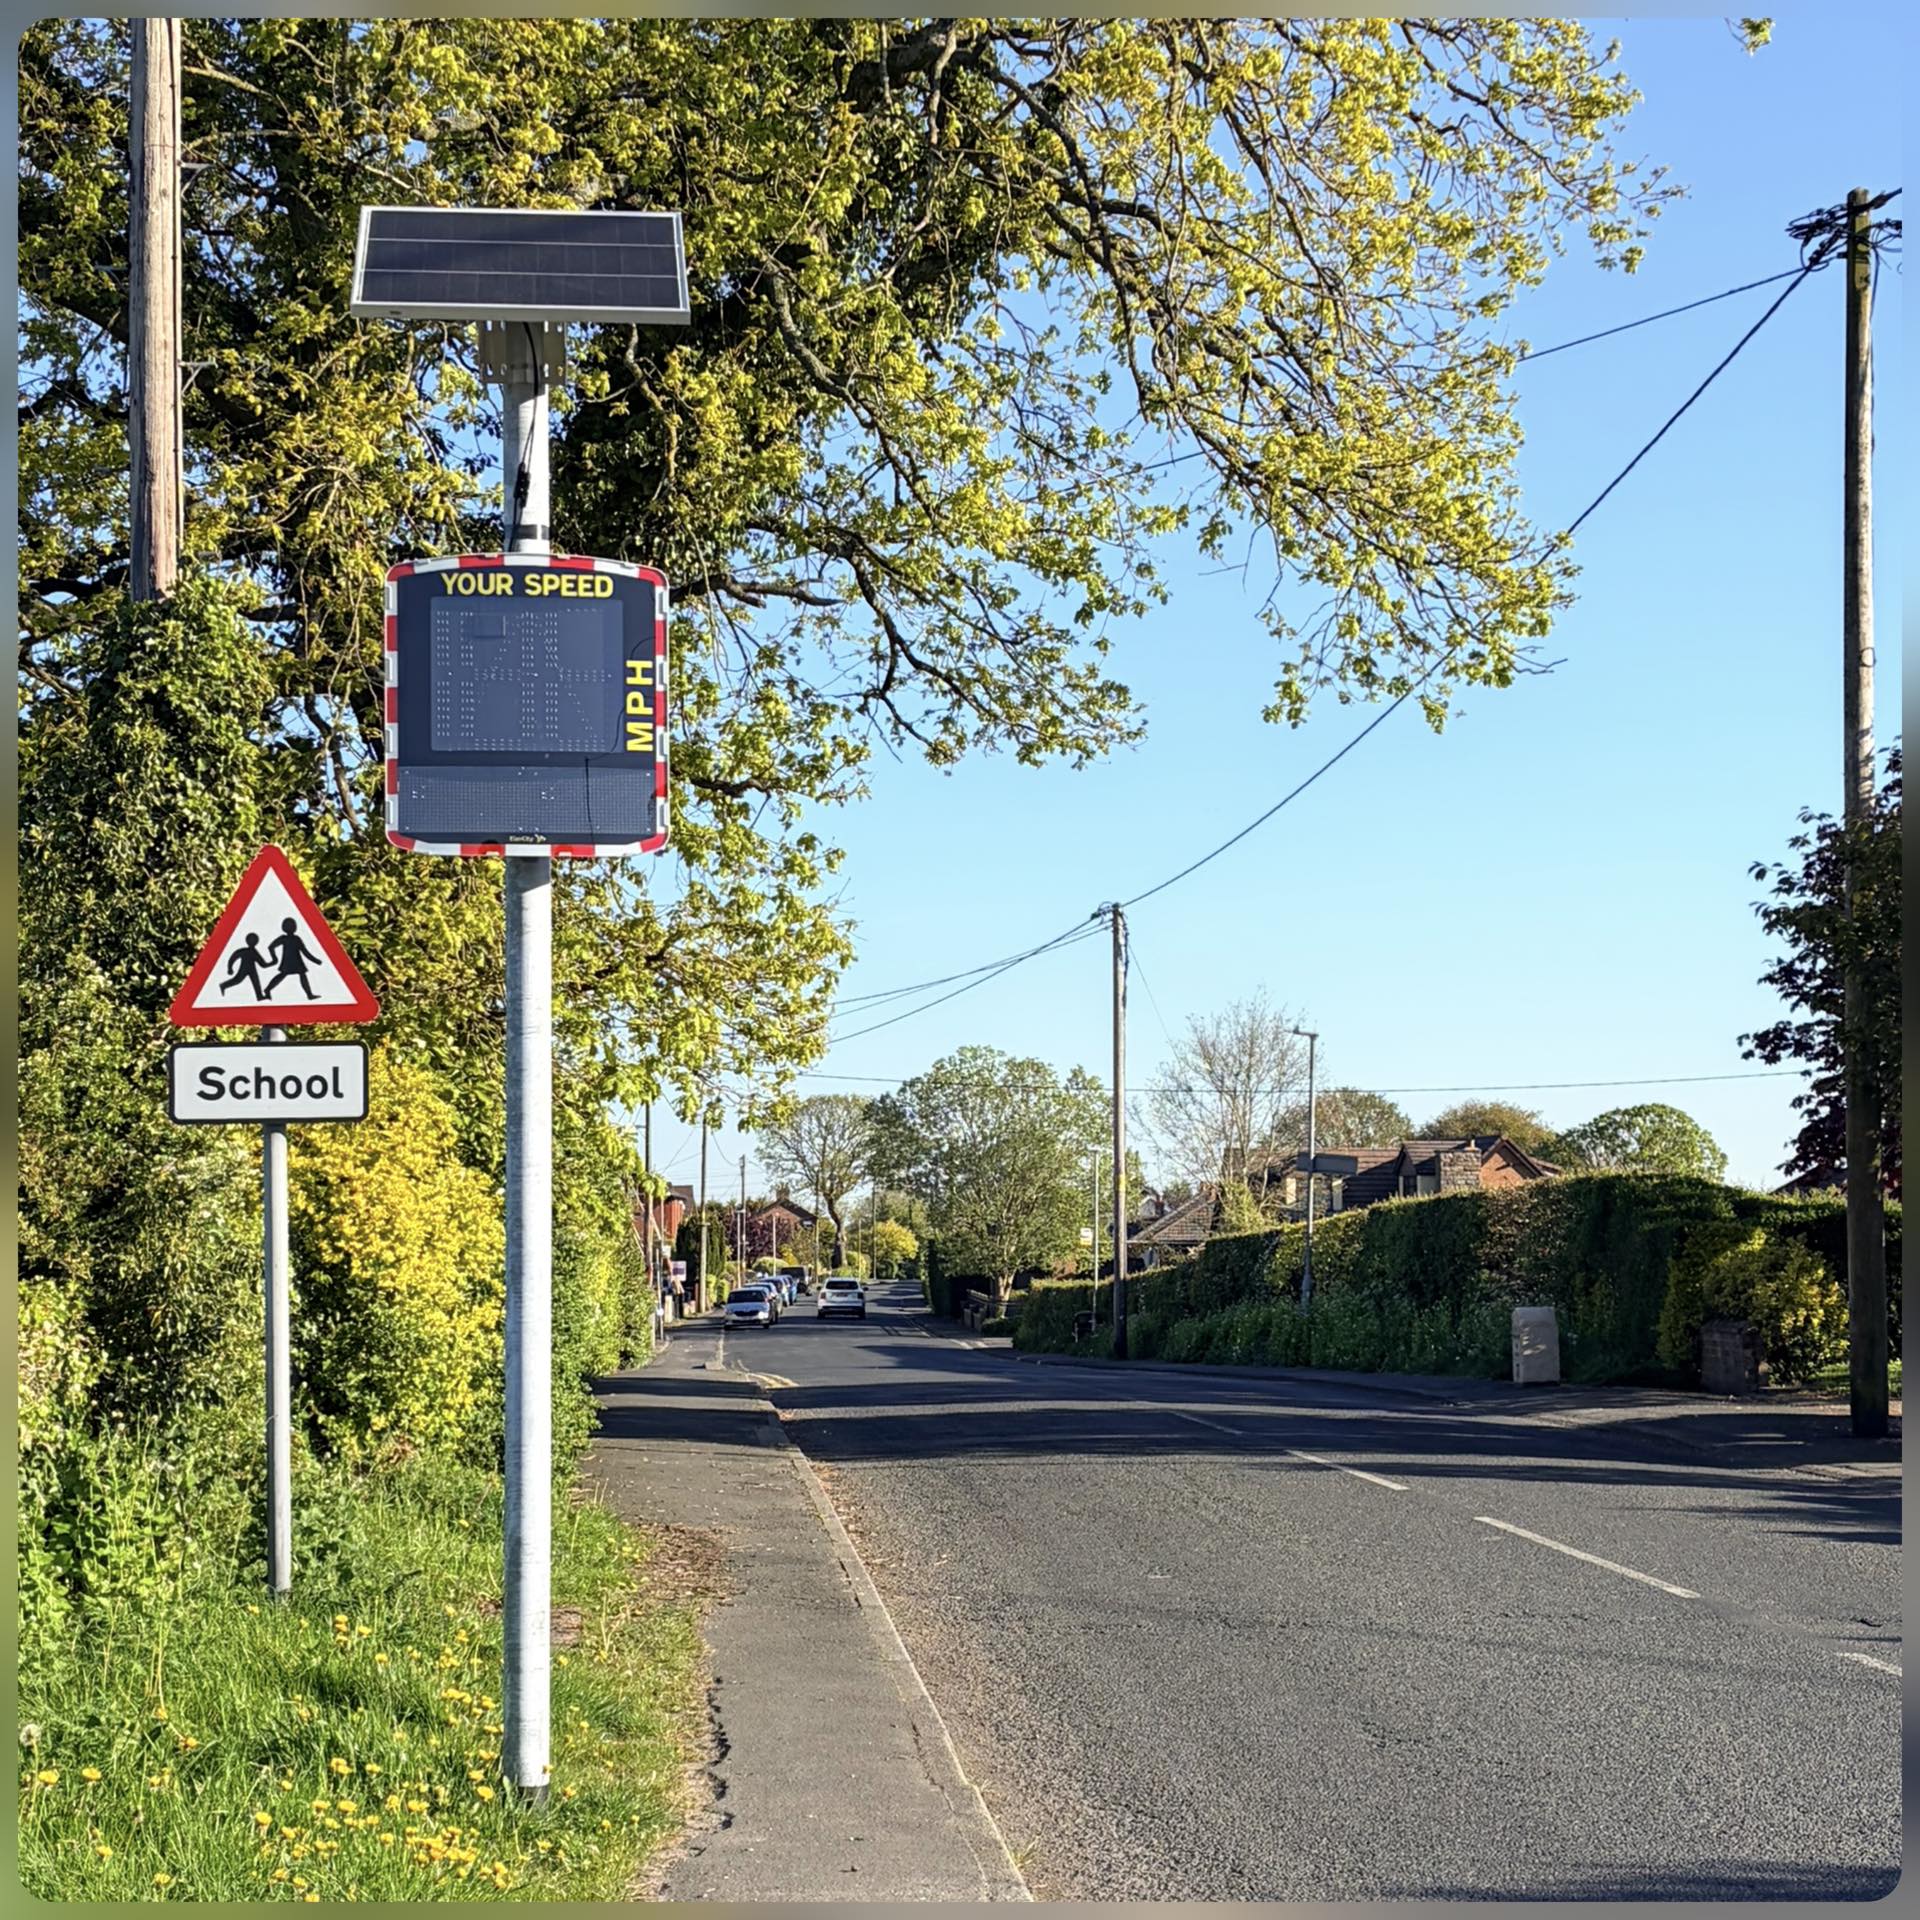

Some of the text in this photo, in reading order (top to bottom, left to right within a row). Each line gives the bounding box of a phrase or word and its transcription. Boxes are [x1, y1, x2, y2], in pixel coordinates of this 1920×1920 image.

[440, 572, 614, 598] YOUR SPEED
[625, 660, 654, 752] MPH
[196, 1066, 344, 1101] School
